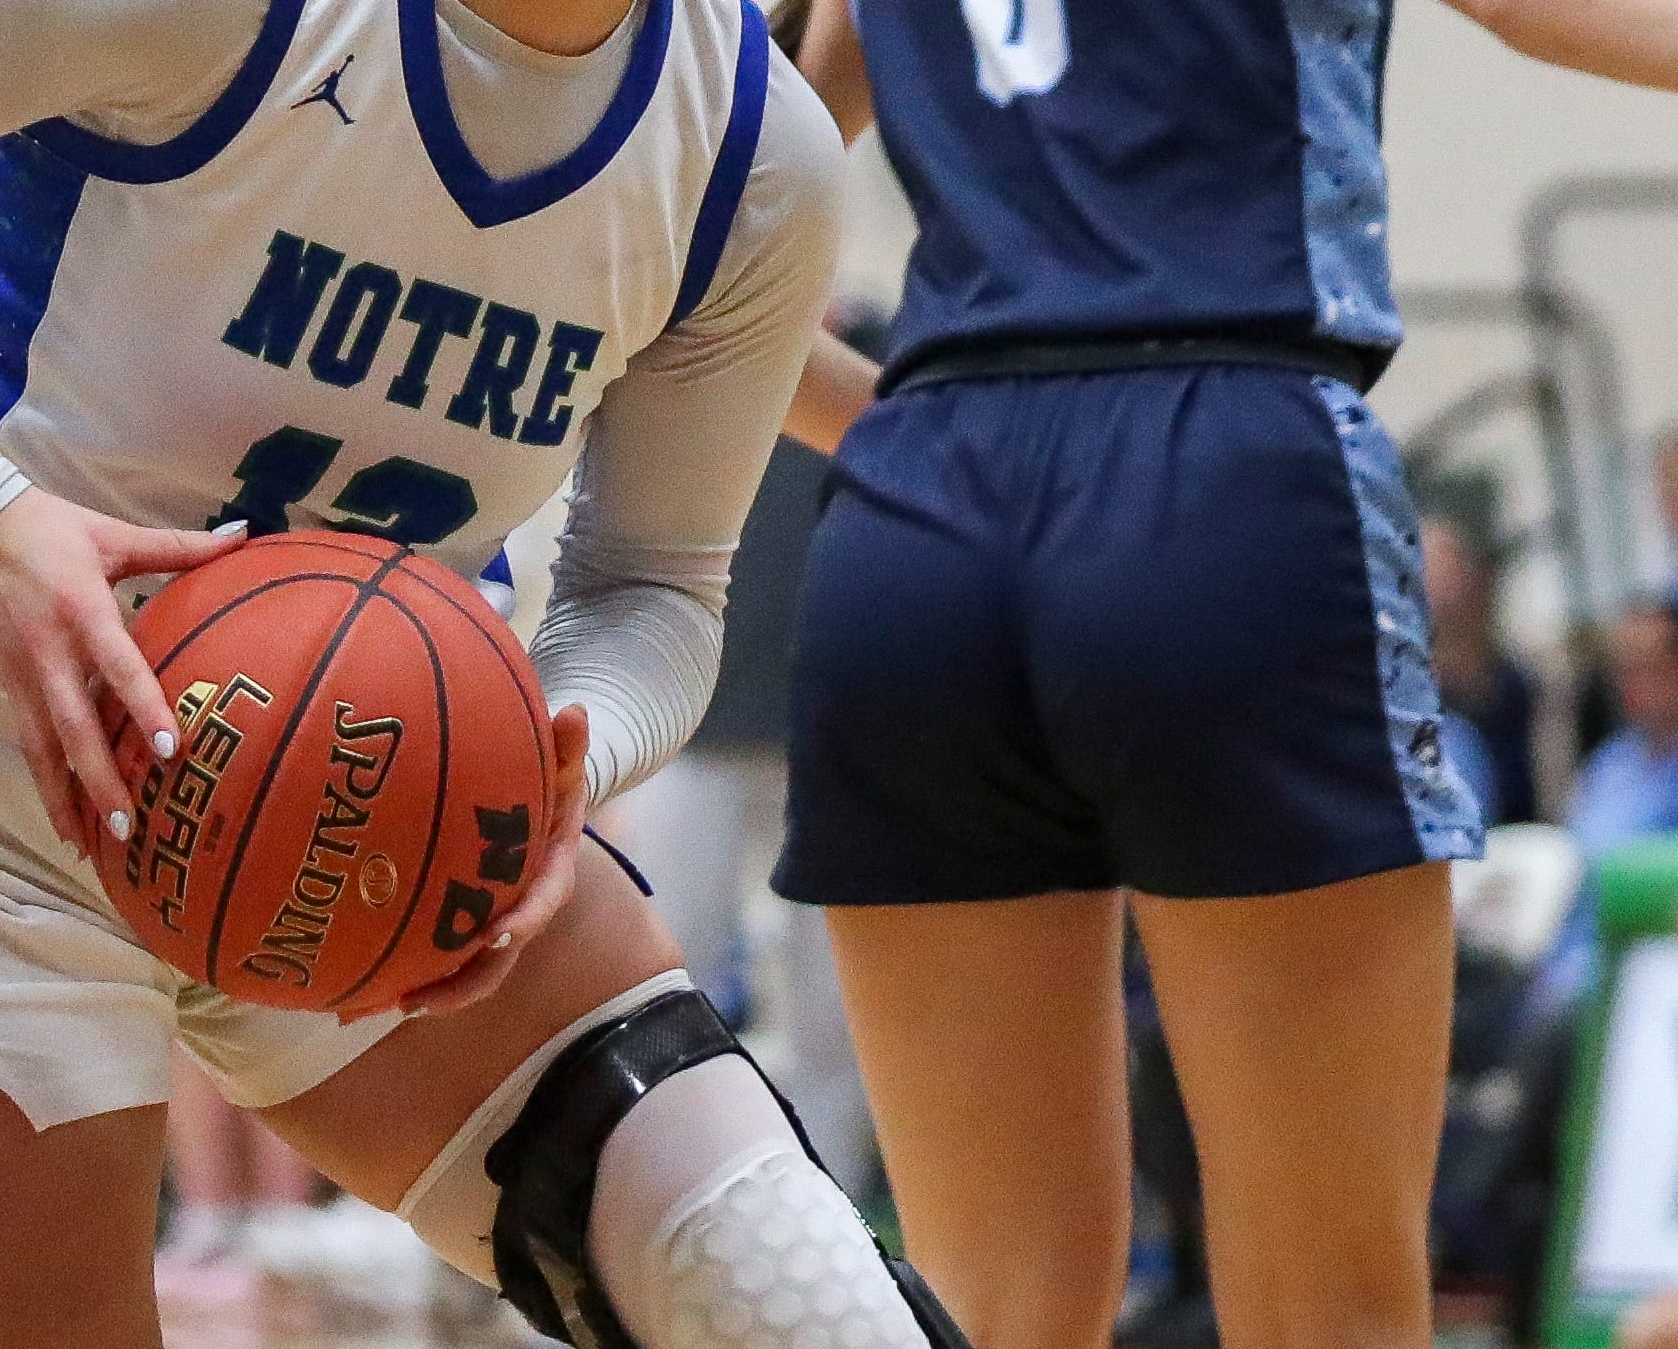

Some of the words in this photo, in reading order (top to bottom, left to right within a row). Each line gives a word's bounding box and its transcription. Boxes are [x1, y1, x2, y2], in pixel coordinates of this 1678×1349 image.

[221, 227, 605, 448] NOTRE
[147, 671, 274, 935] LEGACY
[237, 699, 404, 989] SPALDING
